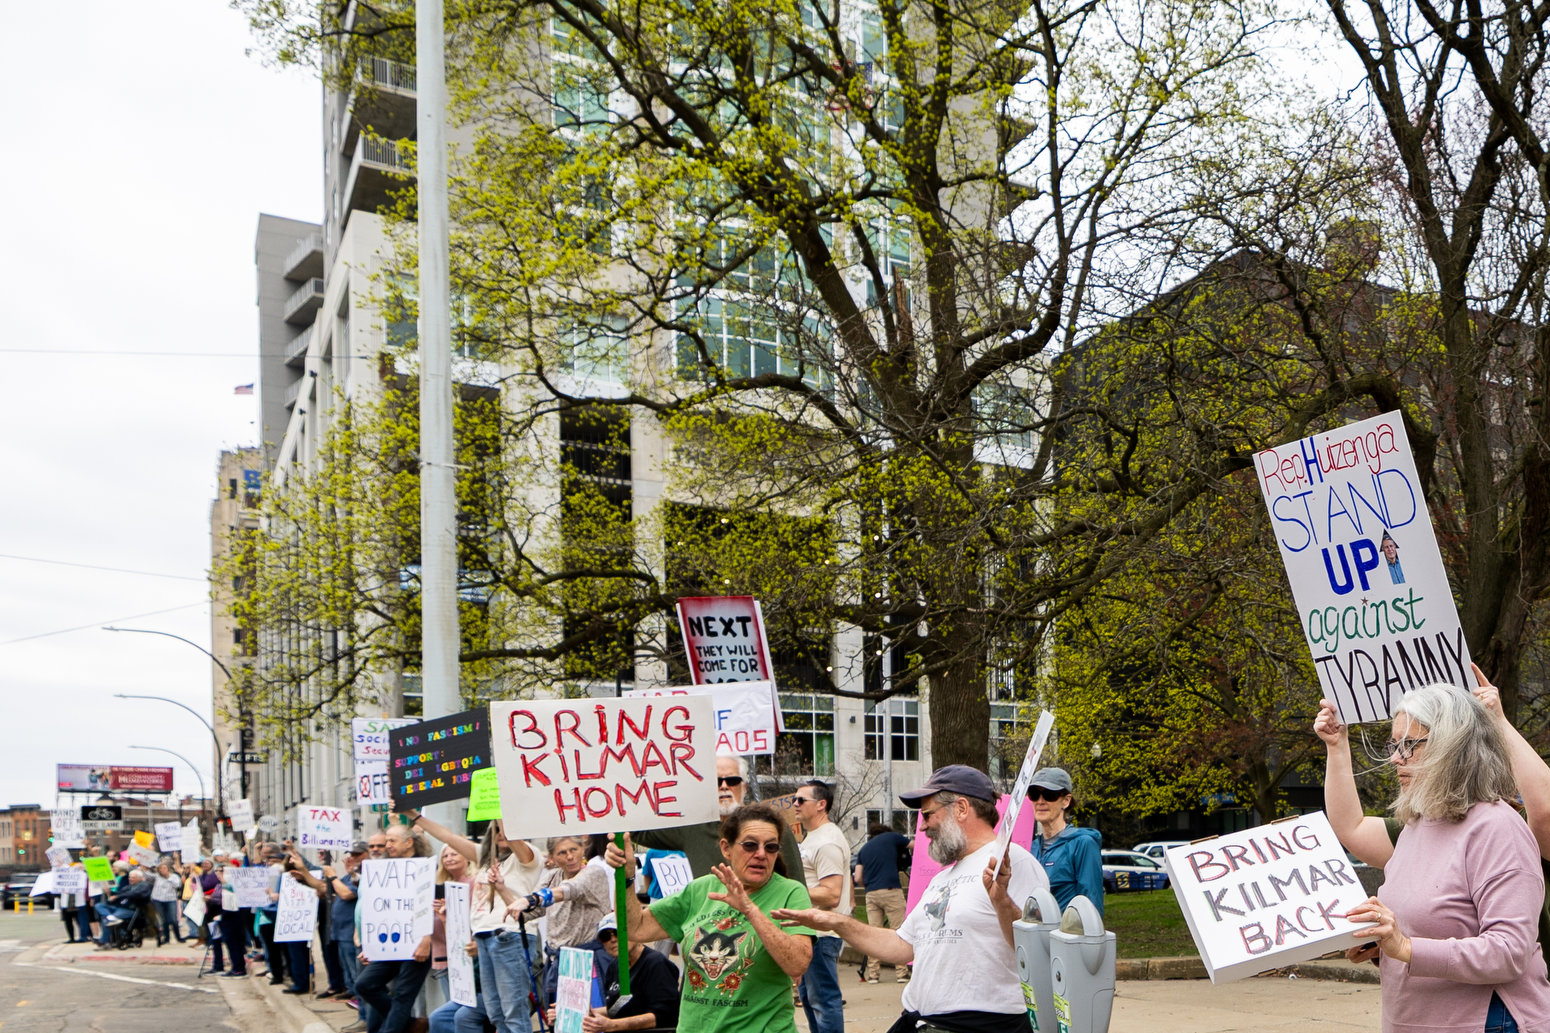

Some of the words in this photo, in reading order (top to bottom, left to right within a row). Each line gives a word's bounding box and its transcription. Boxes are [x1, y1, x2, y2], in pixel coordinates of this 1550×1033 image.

[1300, 422, 1399, 486] Huizenga
[1272, 468, 1417, 553] STAND
[1321, 538, 1380, 595] UP
[687, 616, 752, 638] NEXT
[1308, 587, 1426, 653] against
[695, 645, 723, 657] THEY
[726, 645, 758, 656] WILL
[697, 659, 727, 673] COME
[730, 658, 758, 673] FOR
[1314, 627, 1471, 724] TYRANNY
[508, 704, 695, 751] BRING
[715, 729, 768, 752] AOS
[404, 767, 424, 780] DEI
[435, 755, 482, 773] LGBTQIA
[400, 778, 445, 795] FEDERAL
[554, 779, 685, 825] HOME
[309, 809, 342, 822] TAX
[316, 823, 332, 833] the
[301, 833, 350, 848] Billionaires
[1184, 825, 1322, 884] BRING
[366, 860, 416, 889] WAR
[1203, 858, 1356, 922] KILMAR
[280, 909, 312, 923] SHOP
[373, 897, 390, 912] ON
[395, 898, 415, 912] THE
[278, 922, 313, 936] LOCAL
[366, 920, 416, 945] POOR
[1239, 898, 1348, 956] BACK
